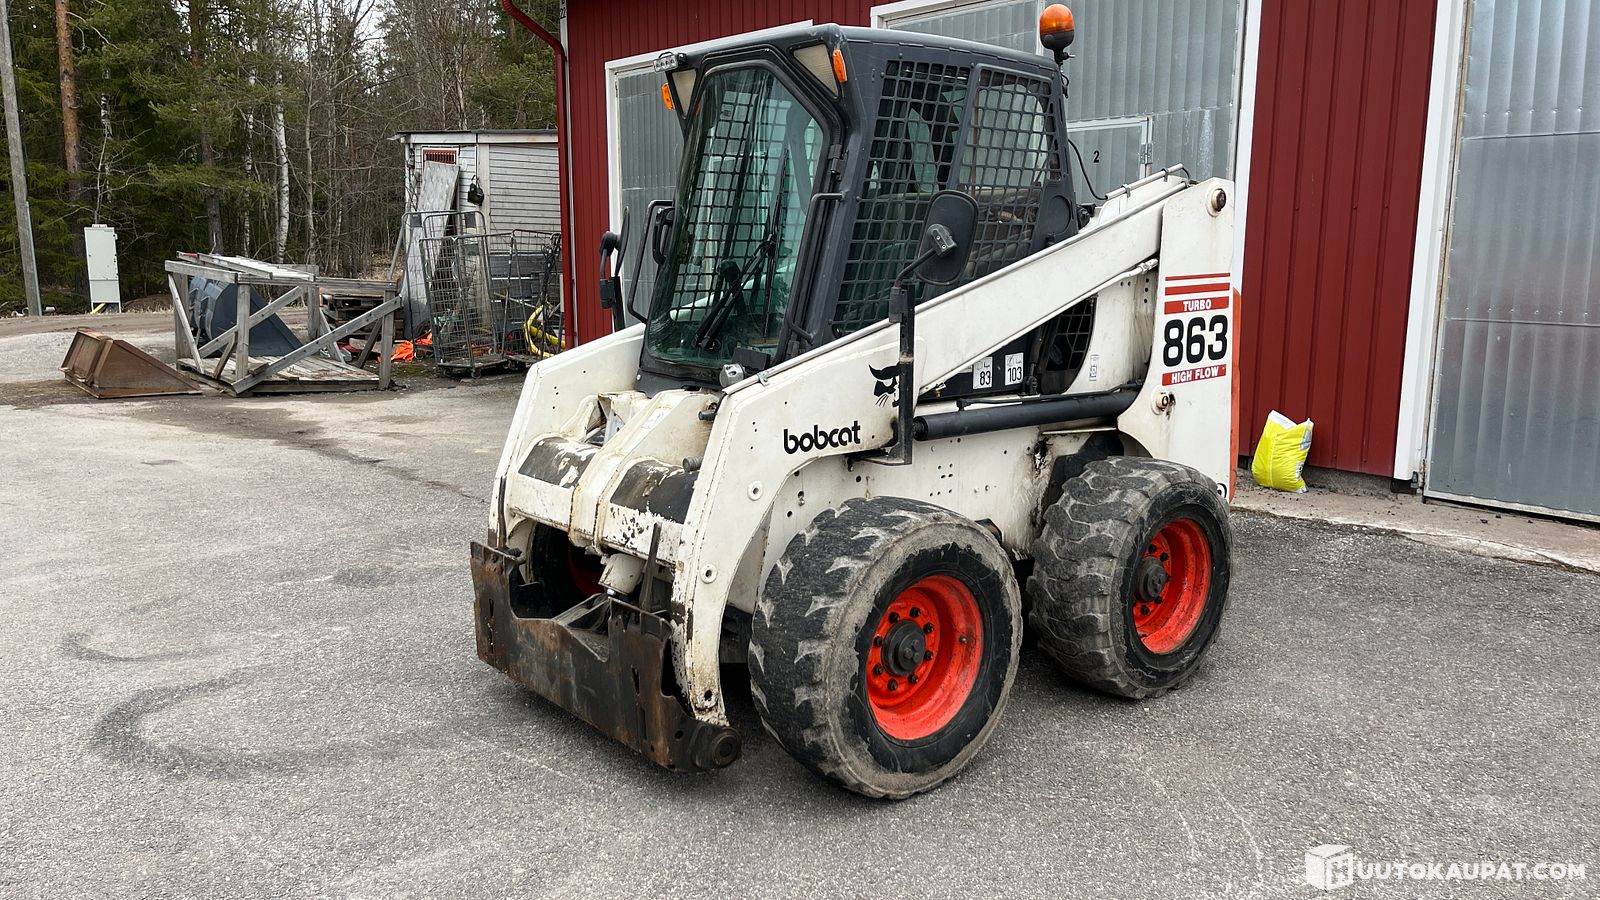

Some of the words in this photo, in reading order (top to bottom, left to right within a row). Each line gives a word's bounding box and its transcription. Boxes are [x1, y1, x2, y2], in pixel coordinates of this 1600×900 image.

[1093, 150, 1100, 163] 2
[1182, 299, 1212, 312] TURBO
[1163, 314, 1229, 367] 863
[979, 370, 991, 386] 83
[1007, 366, 1022, 382] 103
[1171, 370, 1193, 384] HIGH
[1195, 365, 1220, 380] FLOW
[783, 420, 861, 454] bobcat
